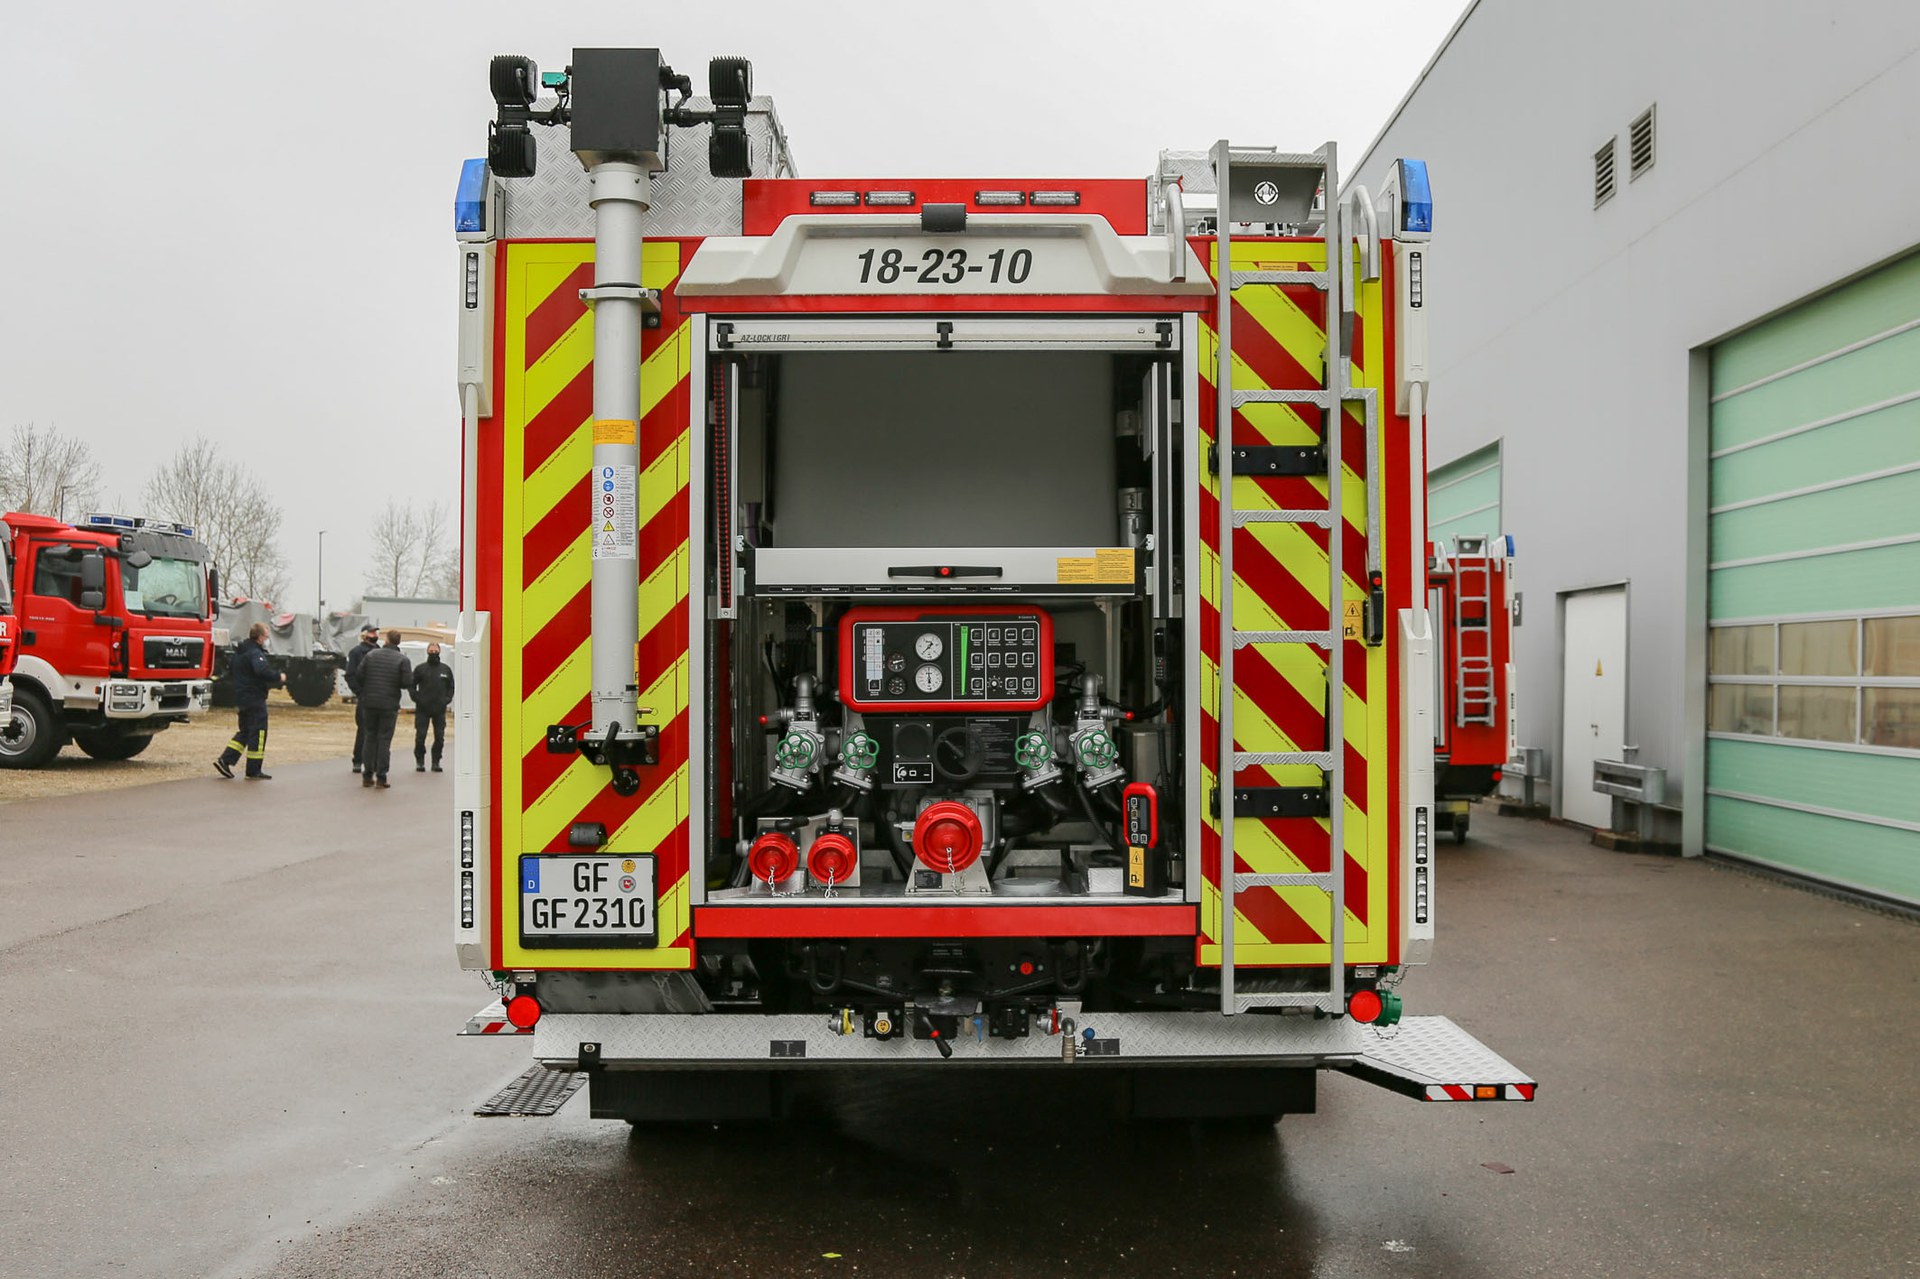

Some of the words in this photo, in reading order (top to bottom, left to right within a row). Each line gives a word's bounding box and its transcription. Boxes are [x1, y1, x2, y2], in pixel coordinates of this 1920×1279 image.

[858, 248, 1033, 284] 18-23-10
[165, 648, 187, 657] MAN
[528, 879, 536, 890] D
[573, 862, 609, 893] GF
[532, 898, 568, 929] GF
[574, 898, 645, 929] 2310
